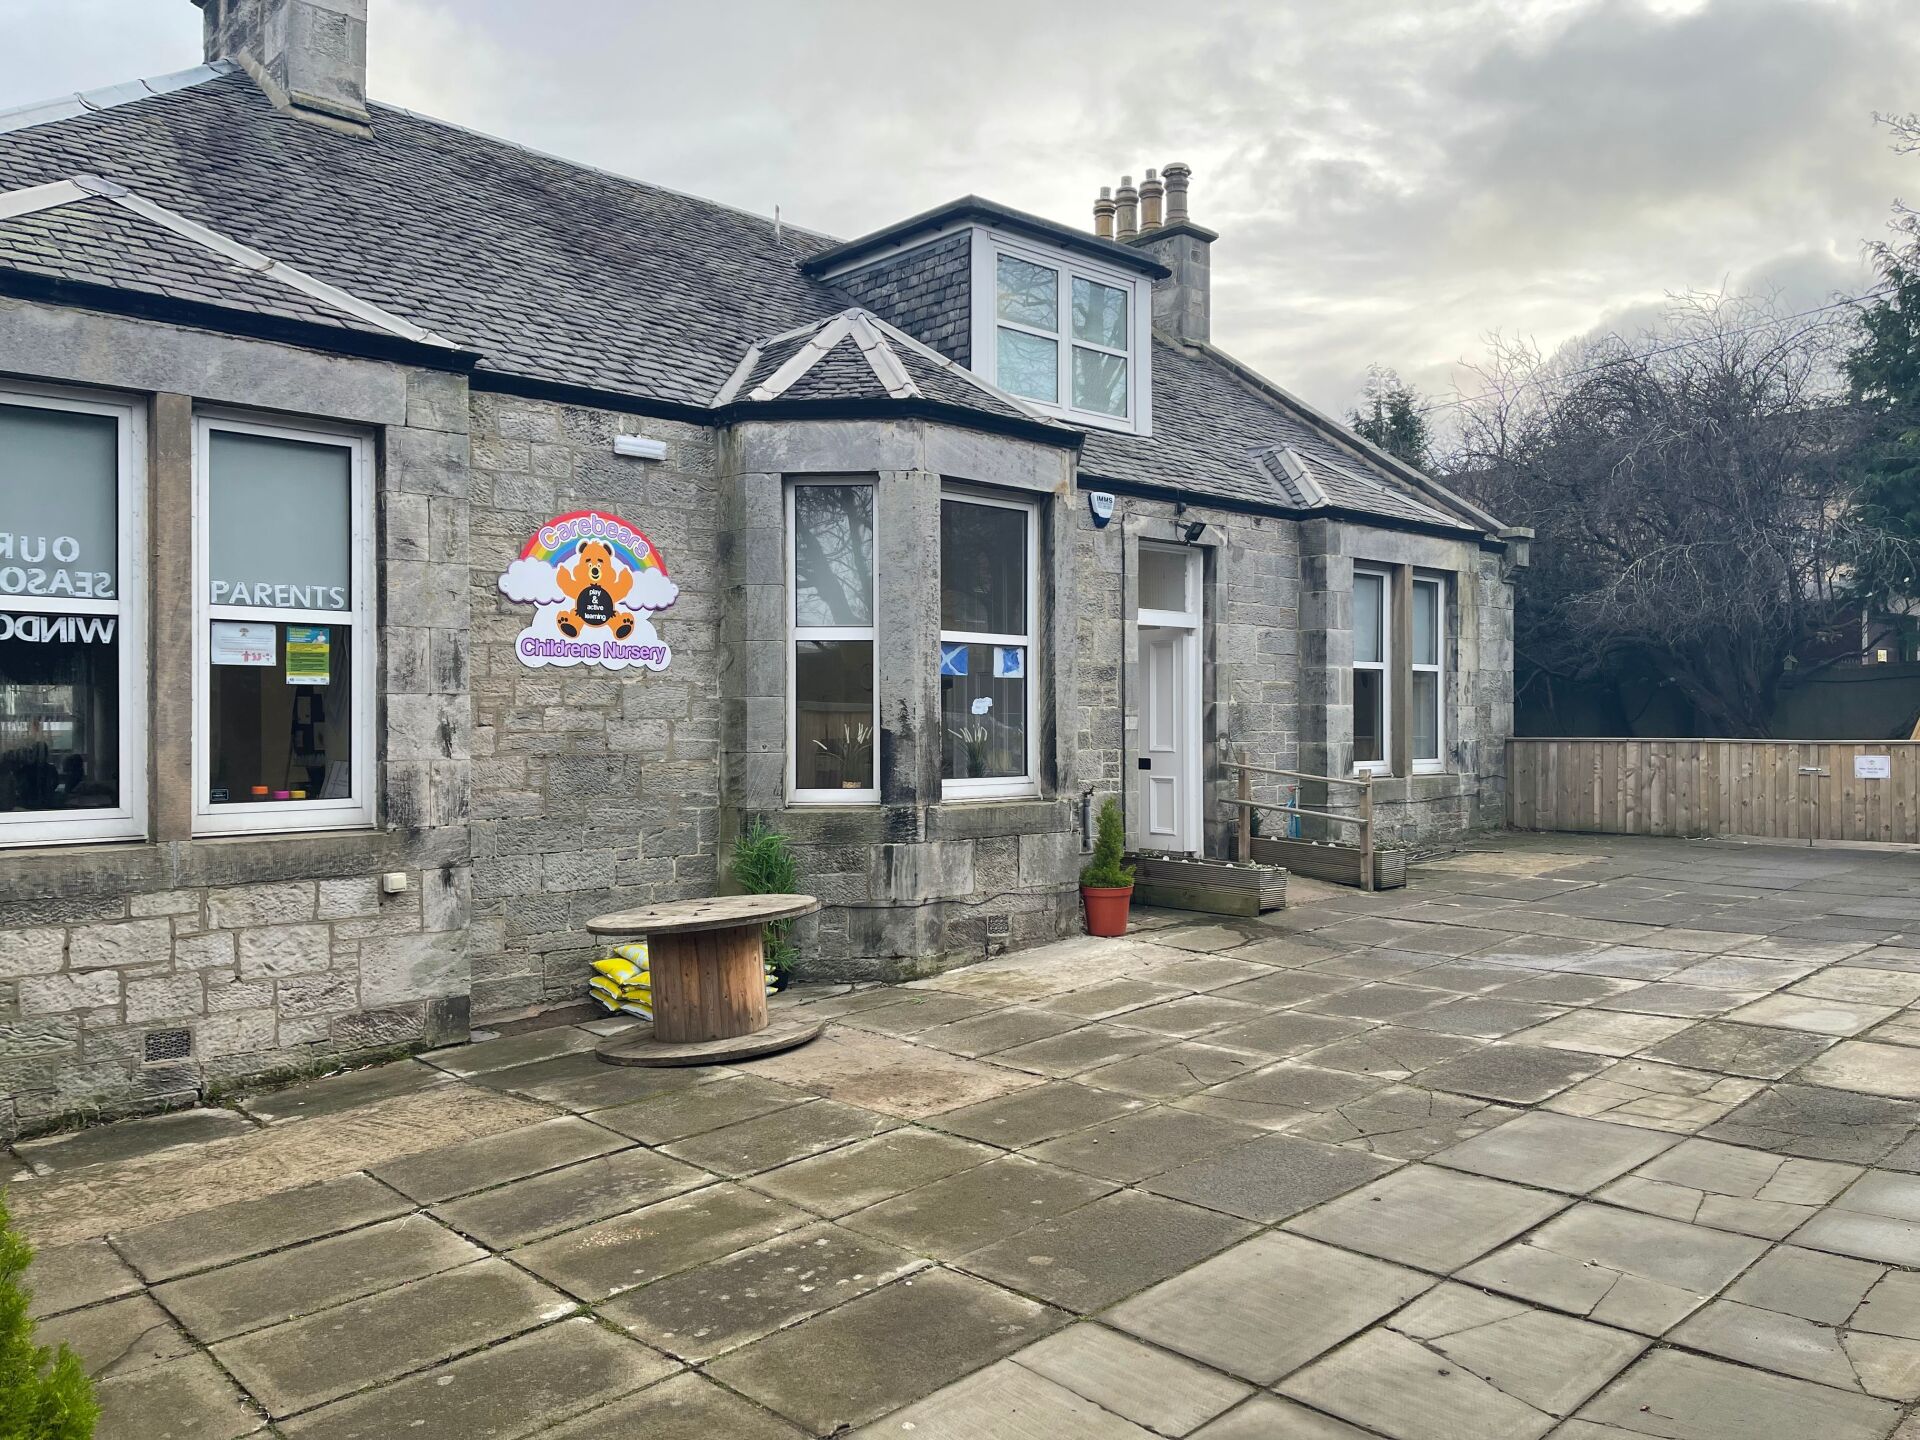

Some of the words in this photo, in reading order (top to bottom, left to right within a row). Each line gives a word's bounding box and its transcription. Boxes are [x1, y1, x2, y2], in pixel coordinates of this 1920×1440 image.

[539, 514, 650, 559] Carebears
[210, 580, 345, 609] PARENTS
[591, 596, 598, 604] &
[584, 613, 606, 621] learning
[520, 637, 601, 659] Childrens
[603, 641, 667, 665] Nursery
